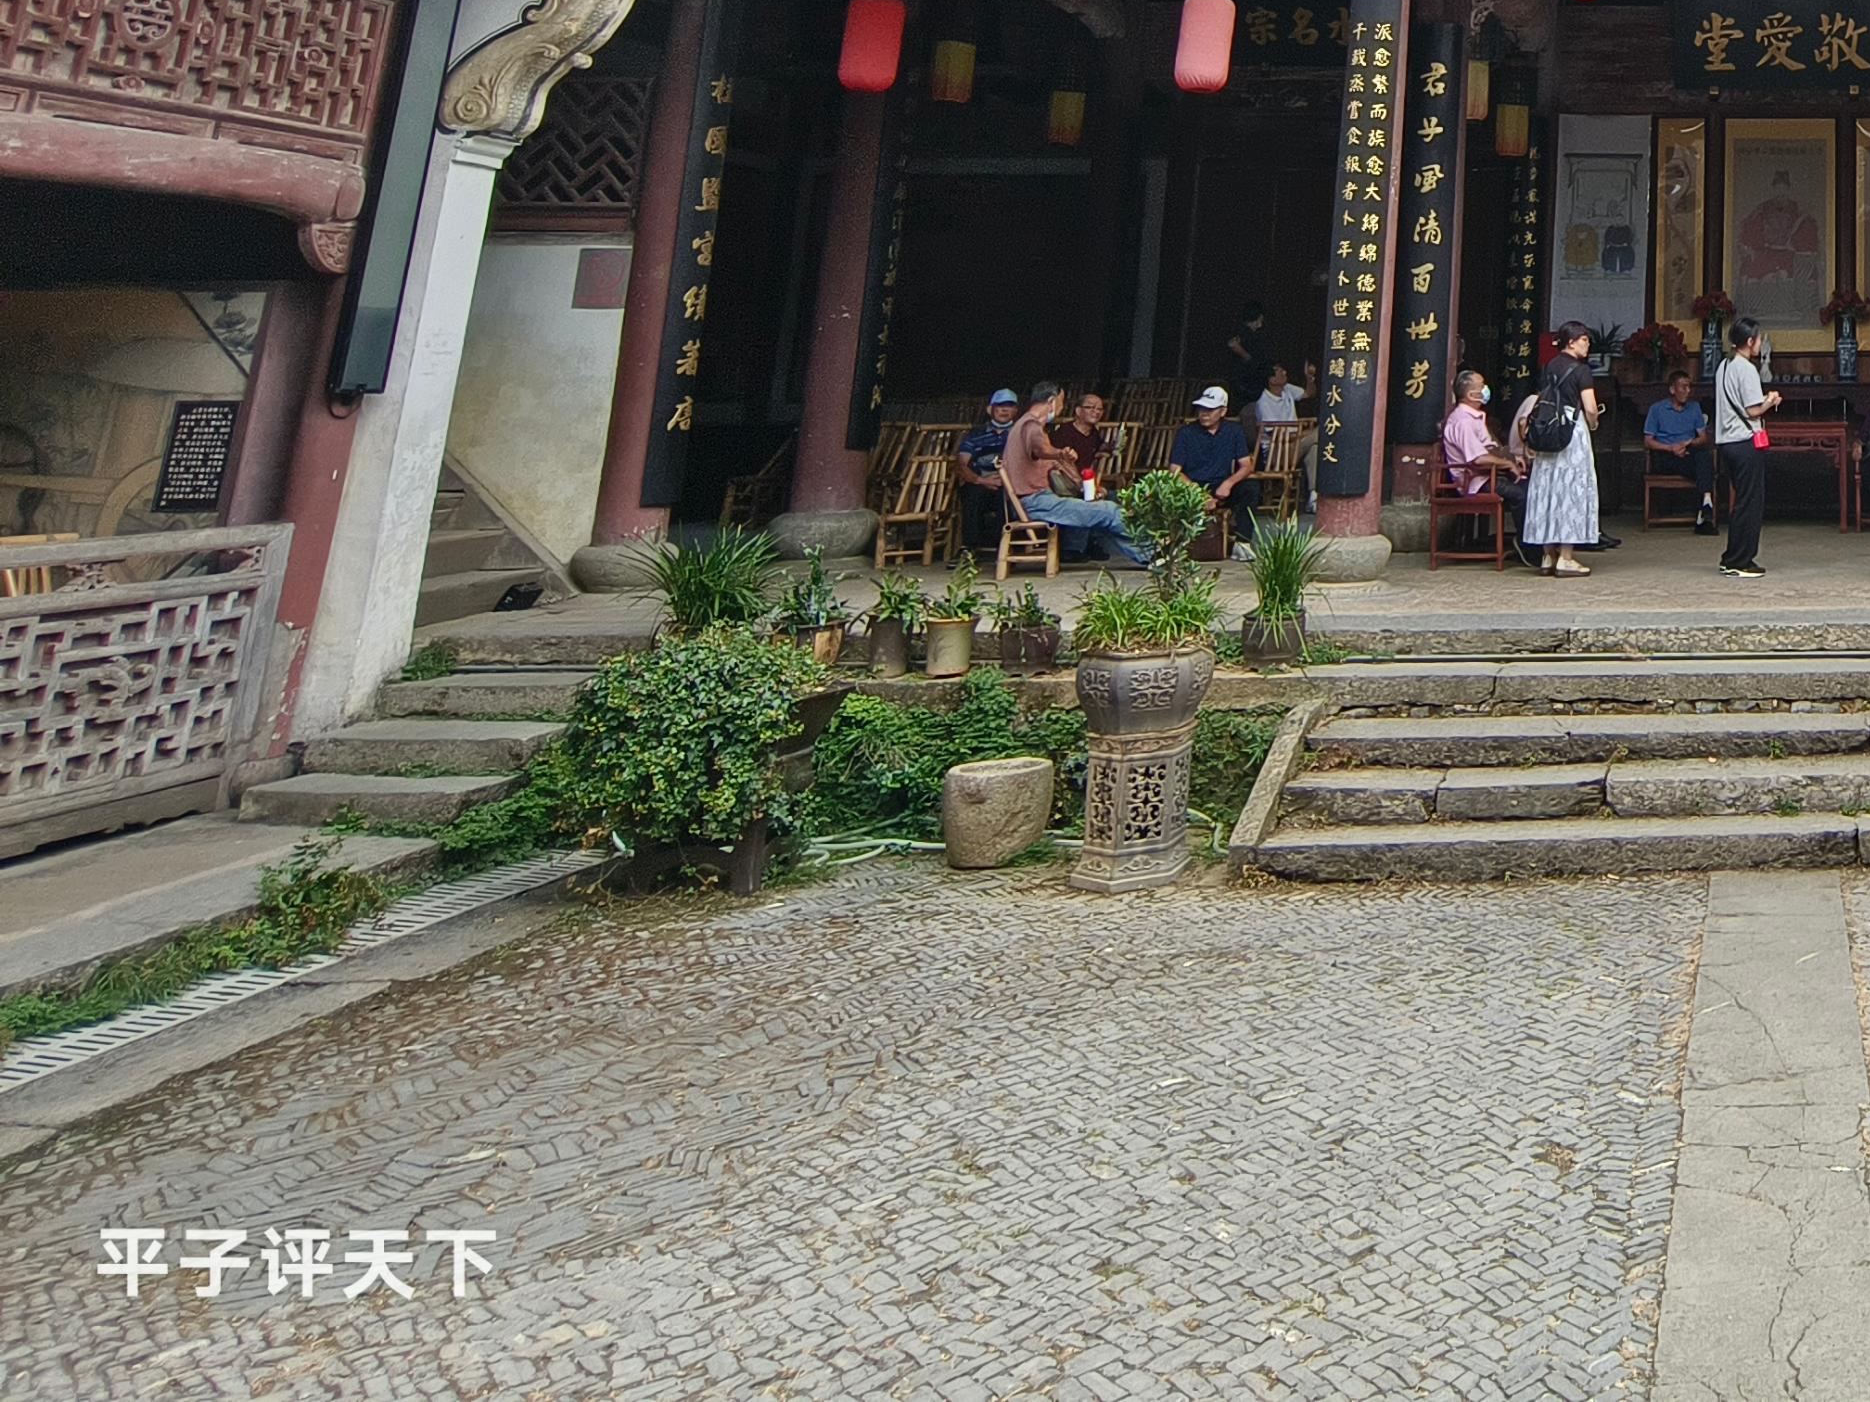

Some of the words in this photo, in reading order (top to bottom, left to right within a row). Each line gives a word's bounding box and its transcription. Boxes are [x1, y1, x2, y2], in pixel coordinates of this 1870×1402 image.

[1404, 62, 1449, 400] 君子風清百世芳
